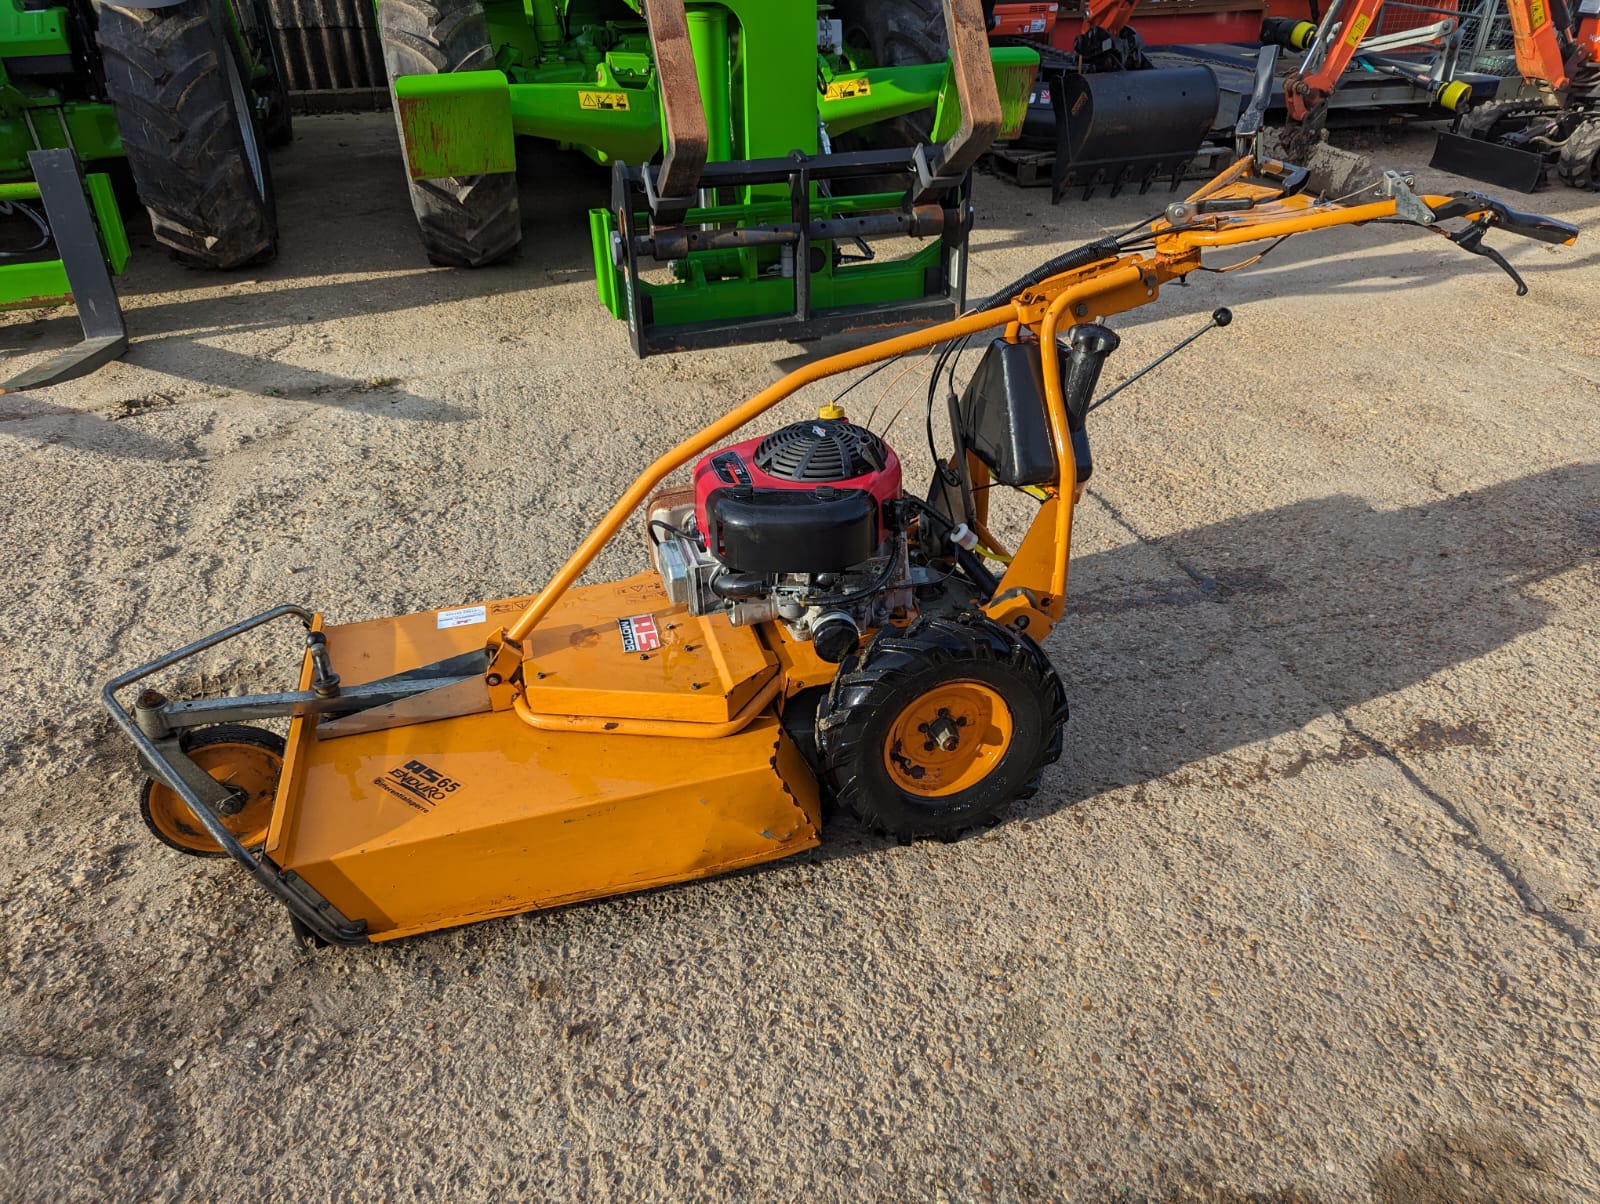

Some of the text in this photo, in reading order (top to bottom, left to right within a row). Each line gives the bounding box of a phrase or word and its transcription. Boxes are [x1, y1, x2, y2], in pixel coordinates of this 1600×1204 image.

[621, 620, 635, 651] MOTOR
[633, 616, 659, 651] AS
[388, 768, 446, 800] ENDURO
[437, 778, 461, 792] 65
